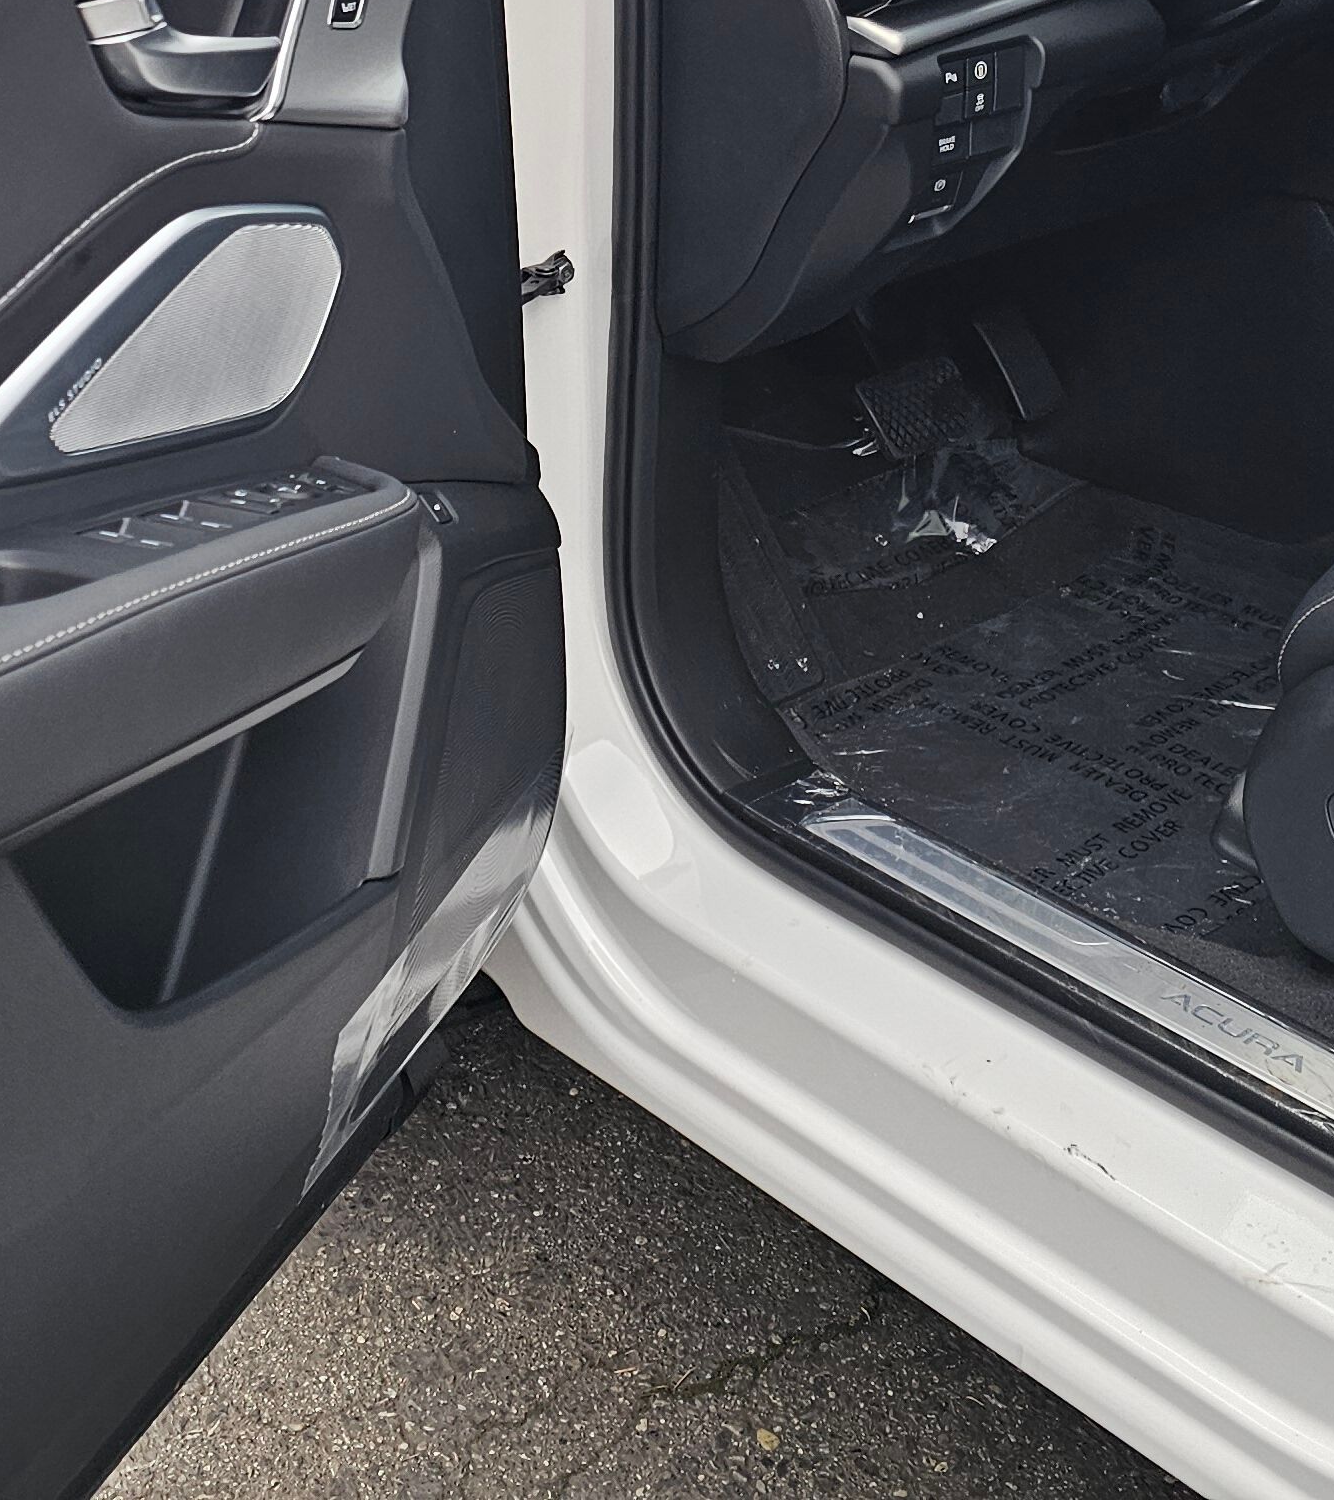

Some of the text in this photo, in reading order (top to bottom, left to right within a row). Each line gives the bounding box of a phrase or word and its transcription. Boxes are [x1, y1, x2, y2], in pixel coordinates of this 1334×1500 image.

[938, 135, 956, 147] BRAKE
[939, 144, 955, 153] HOLD
[1067, 760, 1149, 803] DEALER
[1054, 786, 1194, 870] MUST REMOVE
[1052, 855, 1121, 897] ECTIVE
[1117, 816, 1184, 860] COVER
[1162, 907, 1208, 934] COV
[1159, 993, 1304, 1074] ACURA
